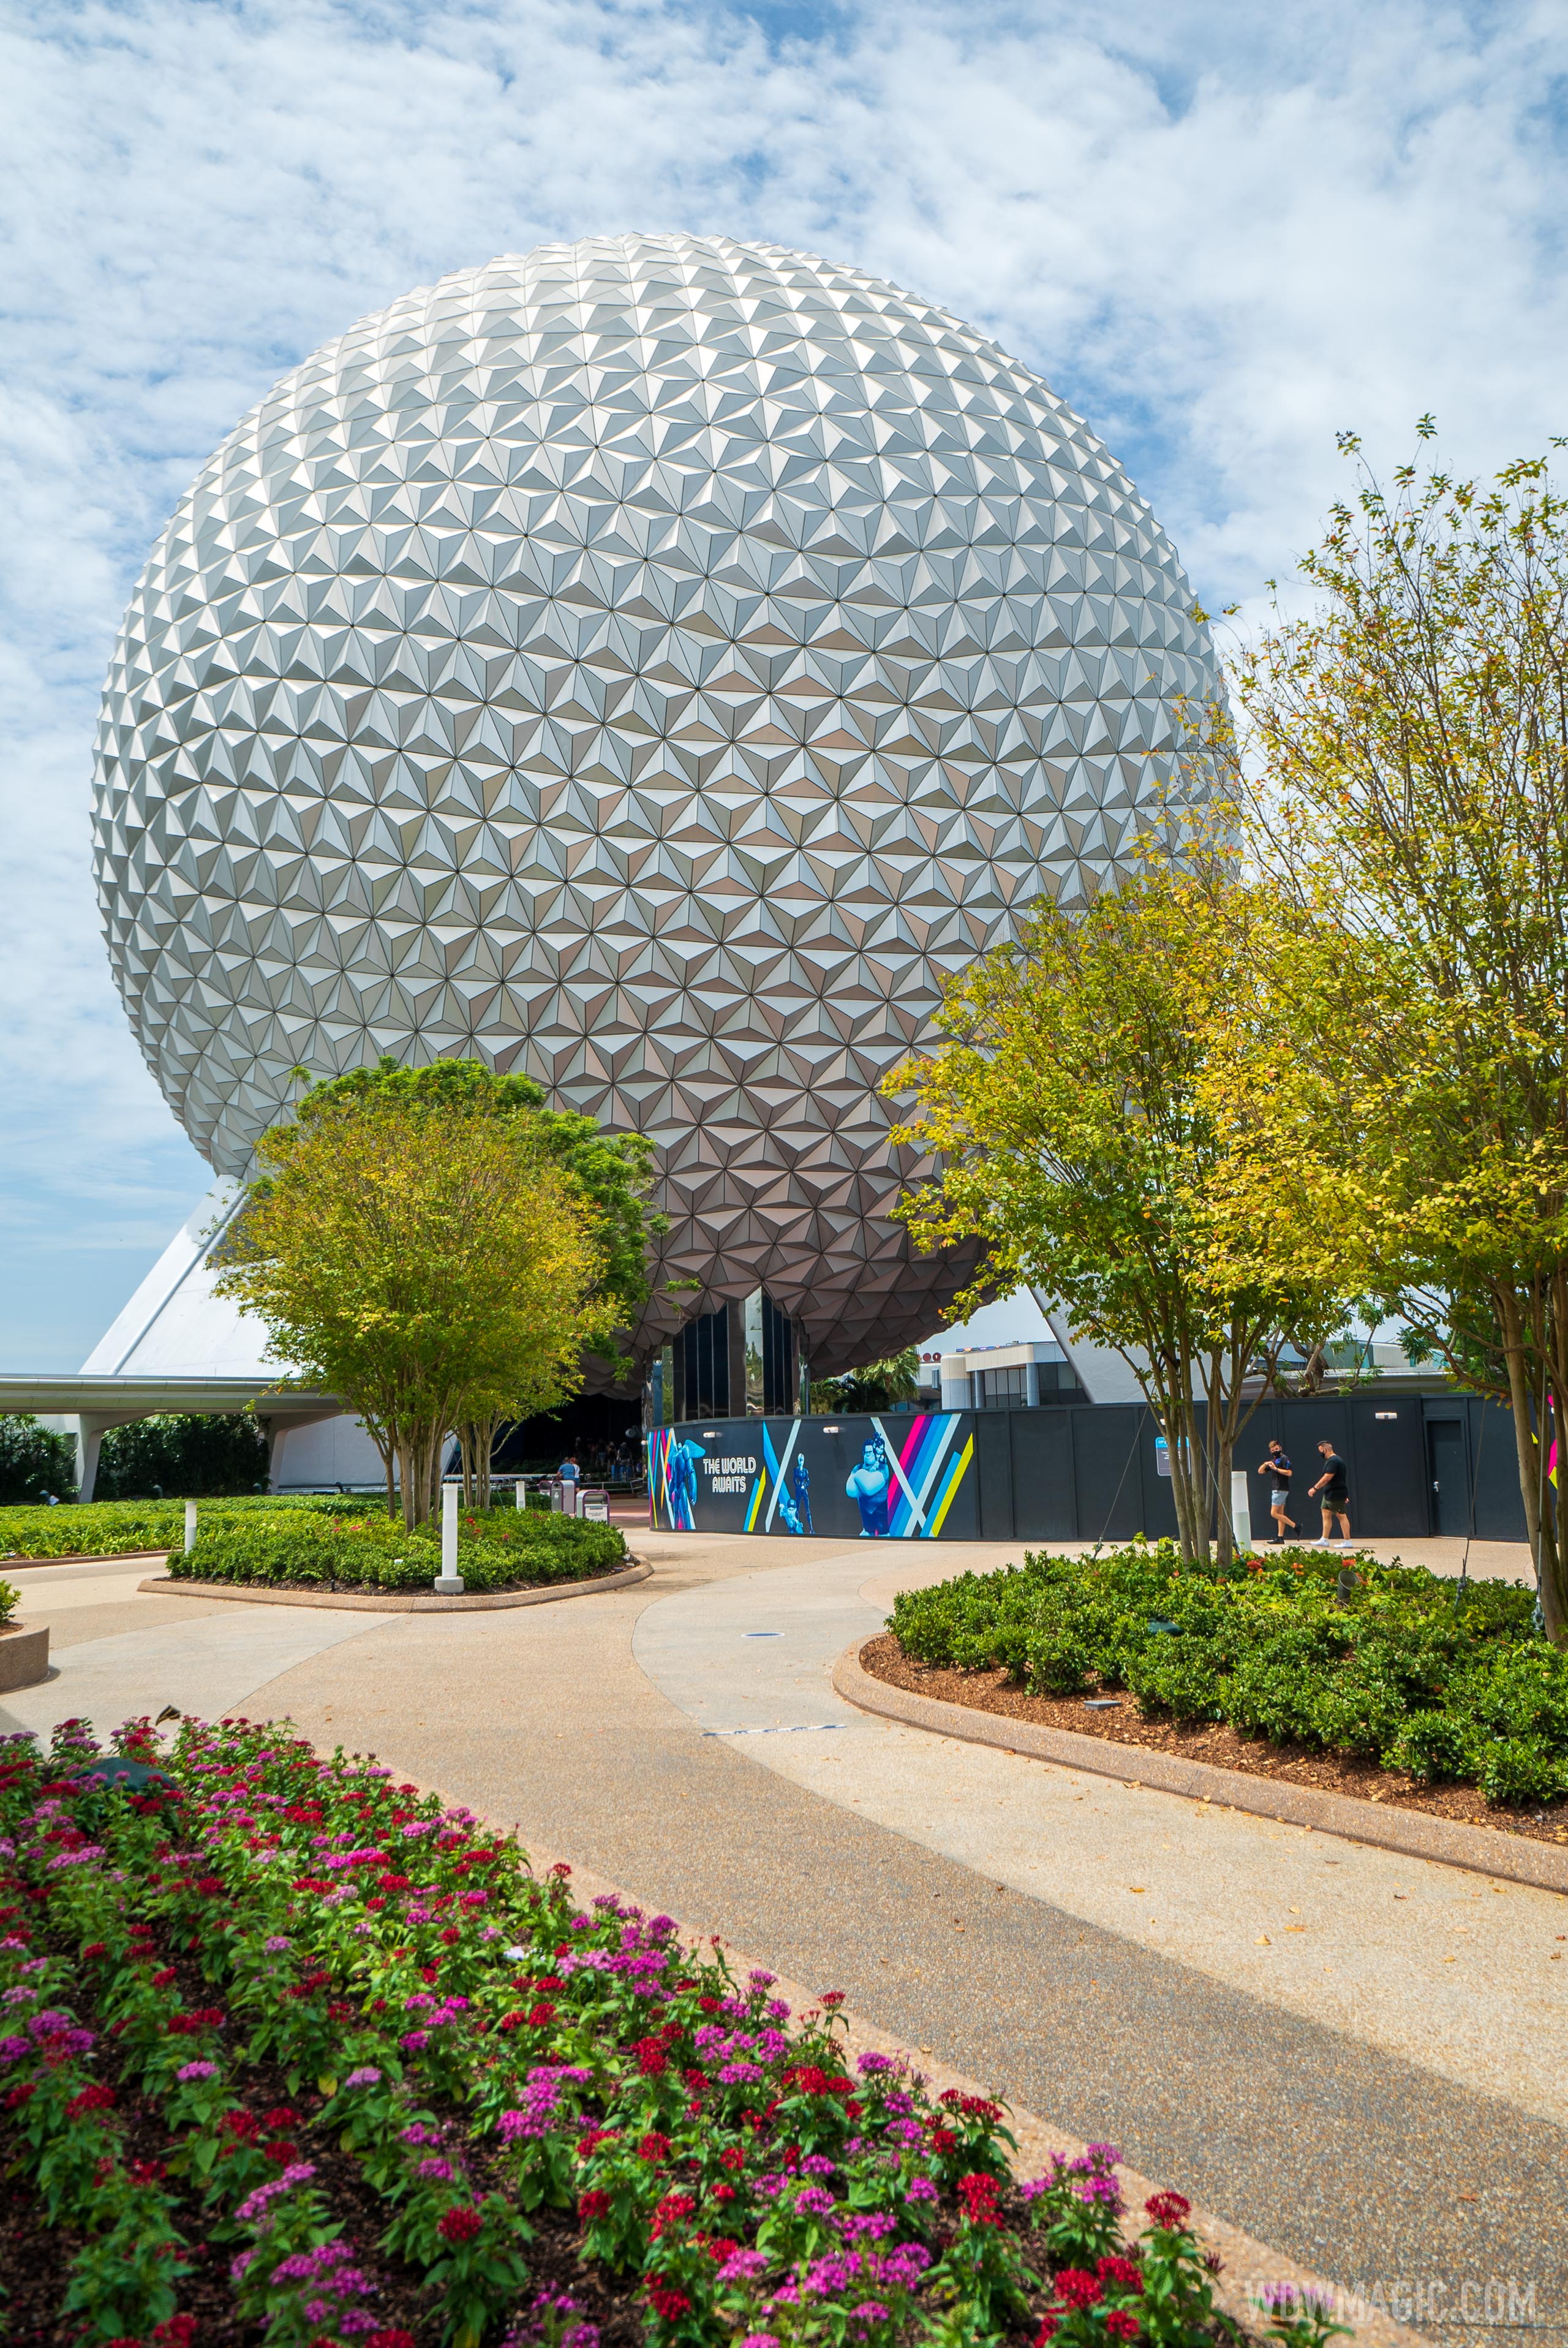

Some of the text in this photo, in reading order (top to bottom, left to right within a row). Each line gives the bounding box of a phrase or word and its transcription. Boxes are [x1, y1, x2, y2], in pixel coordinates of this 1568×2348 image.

[703, 1457, 756, 1474] THE WORLD
[712, 1476, 747, 1493] AWAITS
